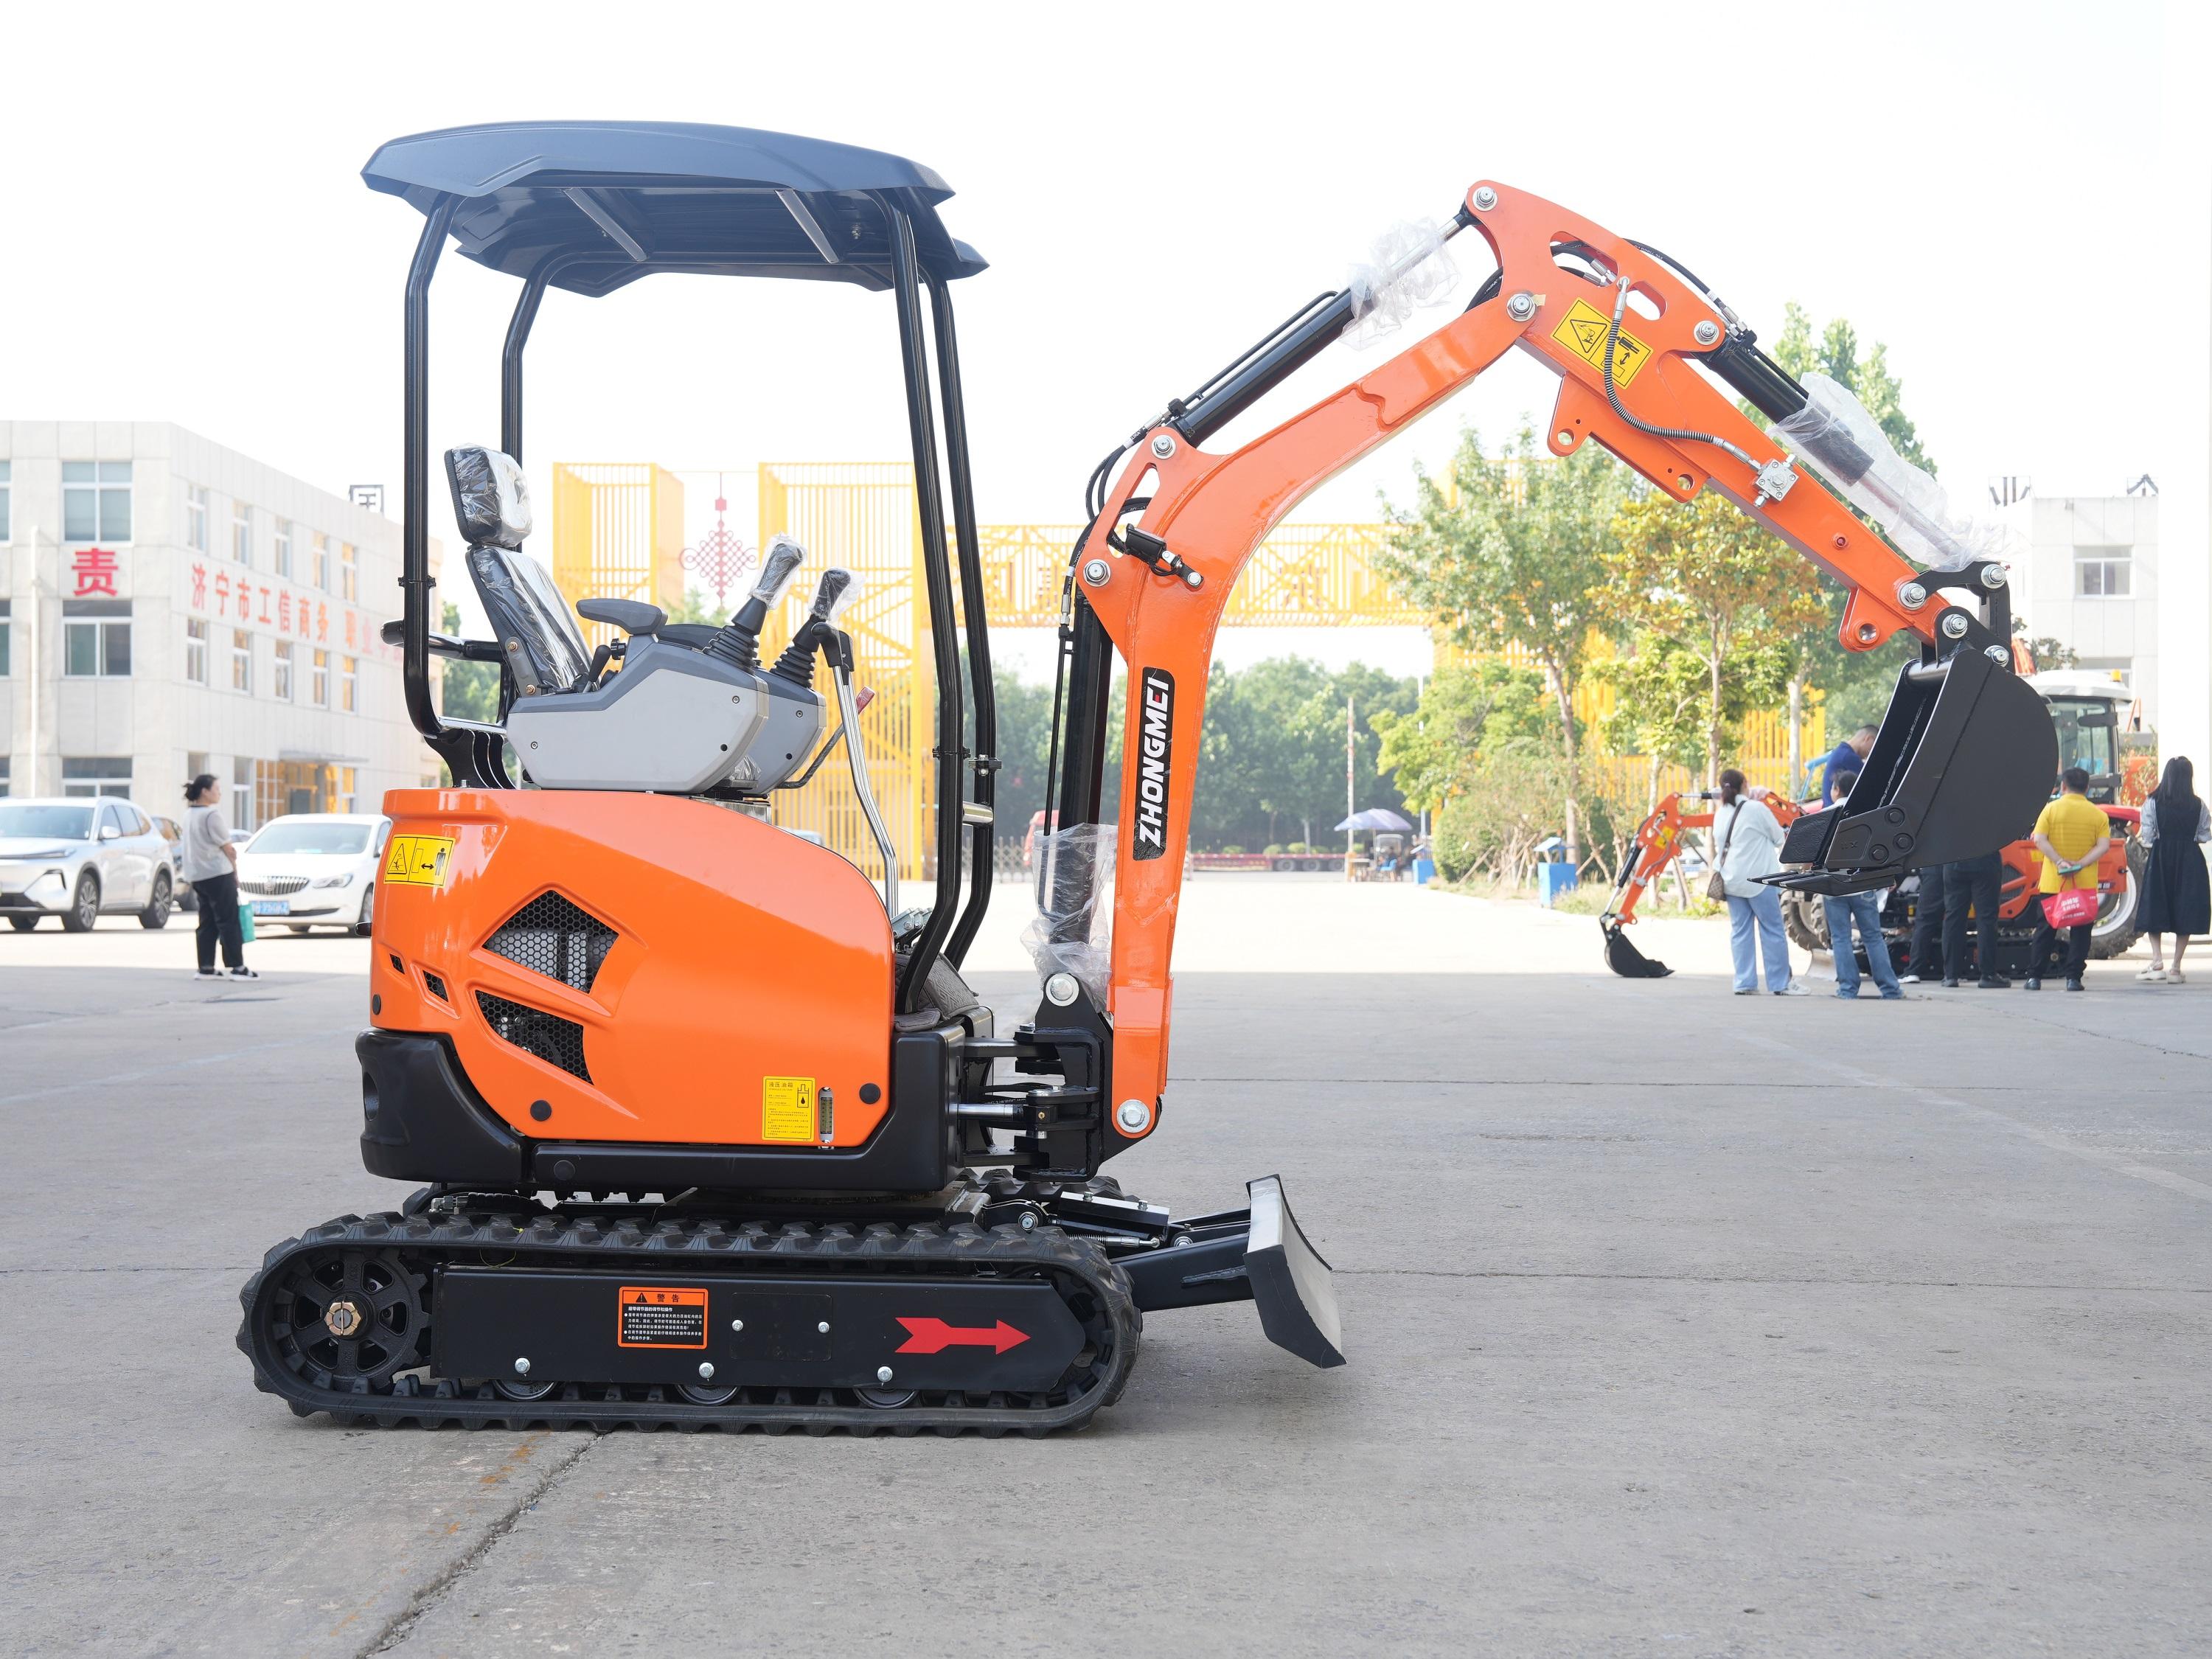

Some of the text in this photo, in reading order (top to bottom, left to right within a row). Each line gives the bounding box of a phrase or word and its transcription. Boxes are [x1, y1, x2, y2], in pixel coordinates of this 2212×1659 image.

[71, 548, 119, 596] 责
[1139, 676, 1169, 849] ZHONGMEI
[657, 1293, 680, 1303] 警告
